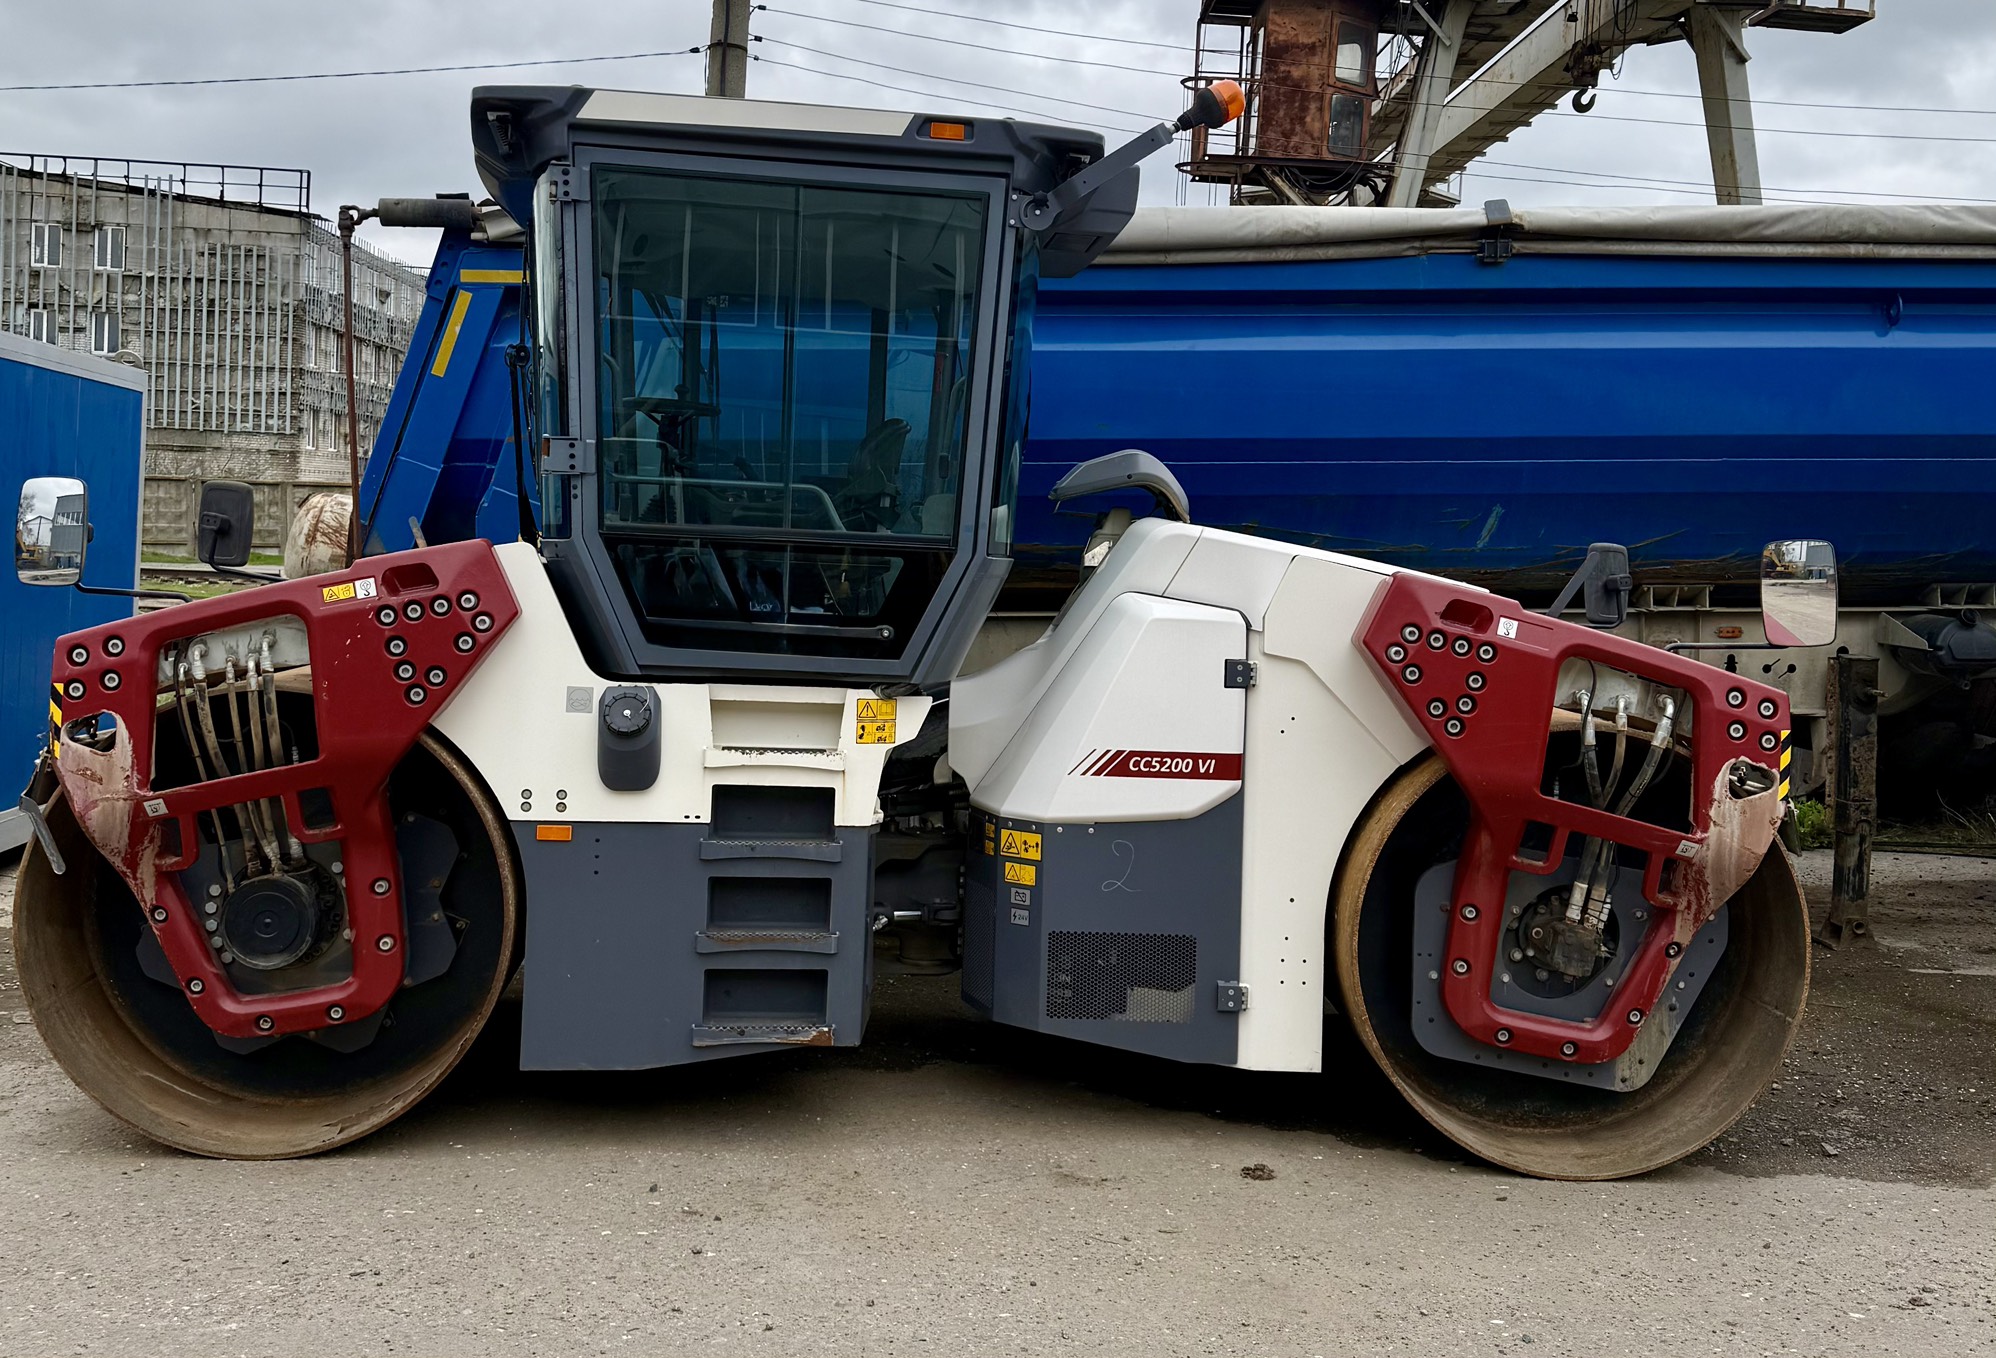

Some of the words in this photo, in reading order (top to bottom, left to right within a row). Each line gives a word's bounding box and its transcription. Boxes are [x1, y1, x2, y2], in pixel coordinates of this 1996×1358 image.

[1129, 757, 1193, 773] CC5200
[1198, 759, 1216, 774] VI
[1101, 839, 1142, 892] 2
